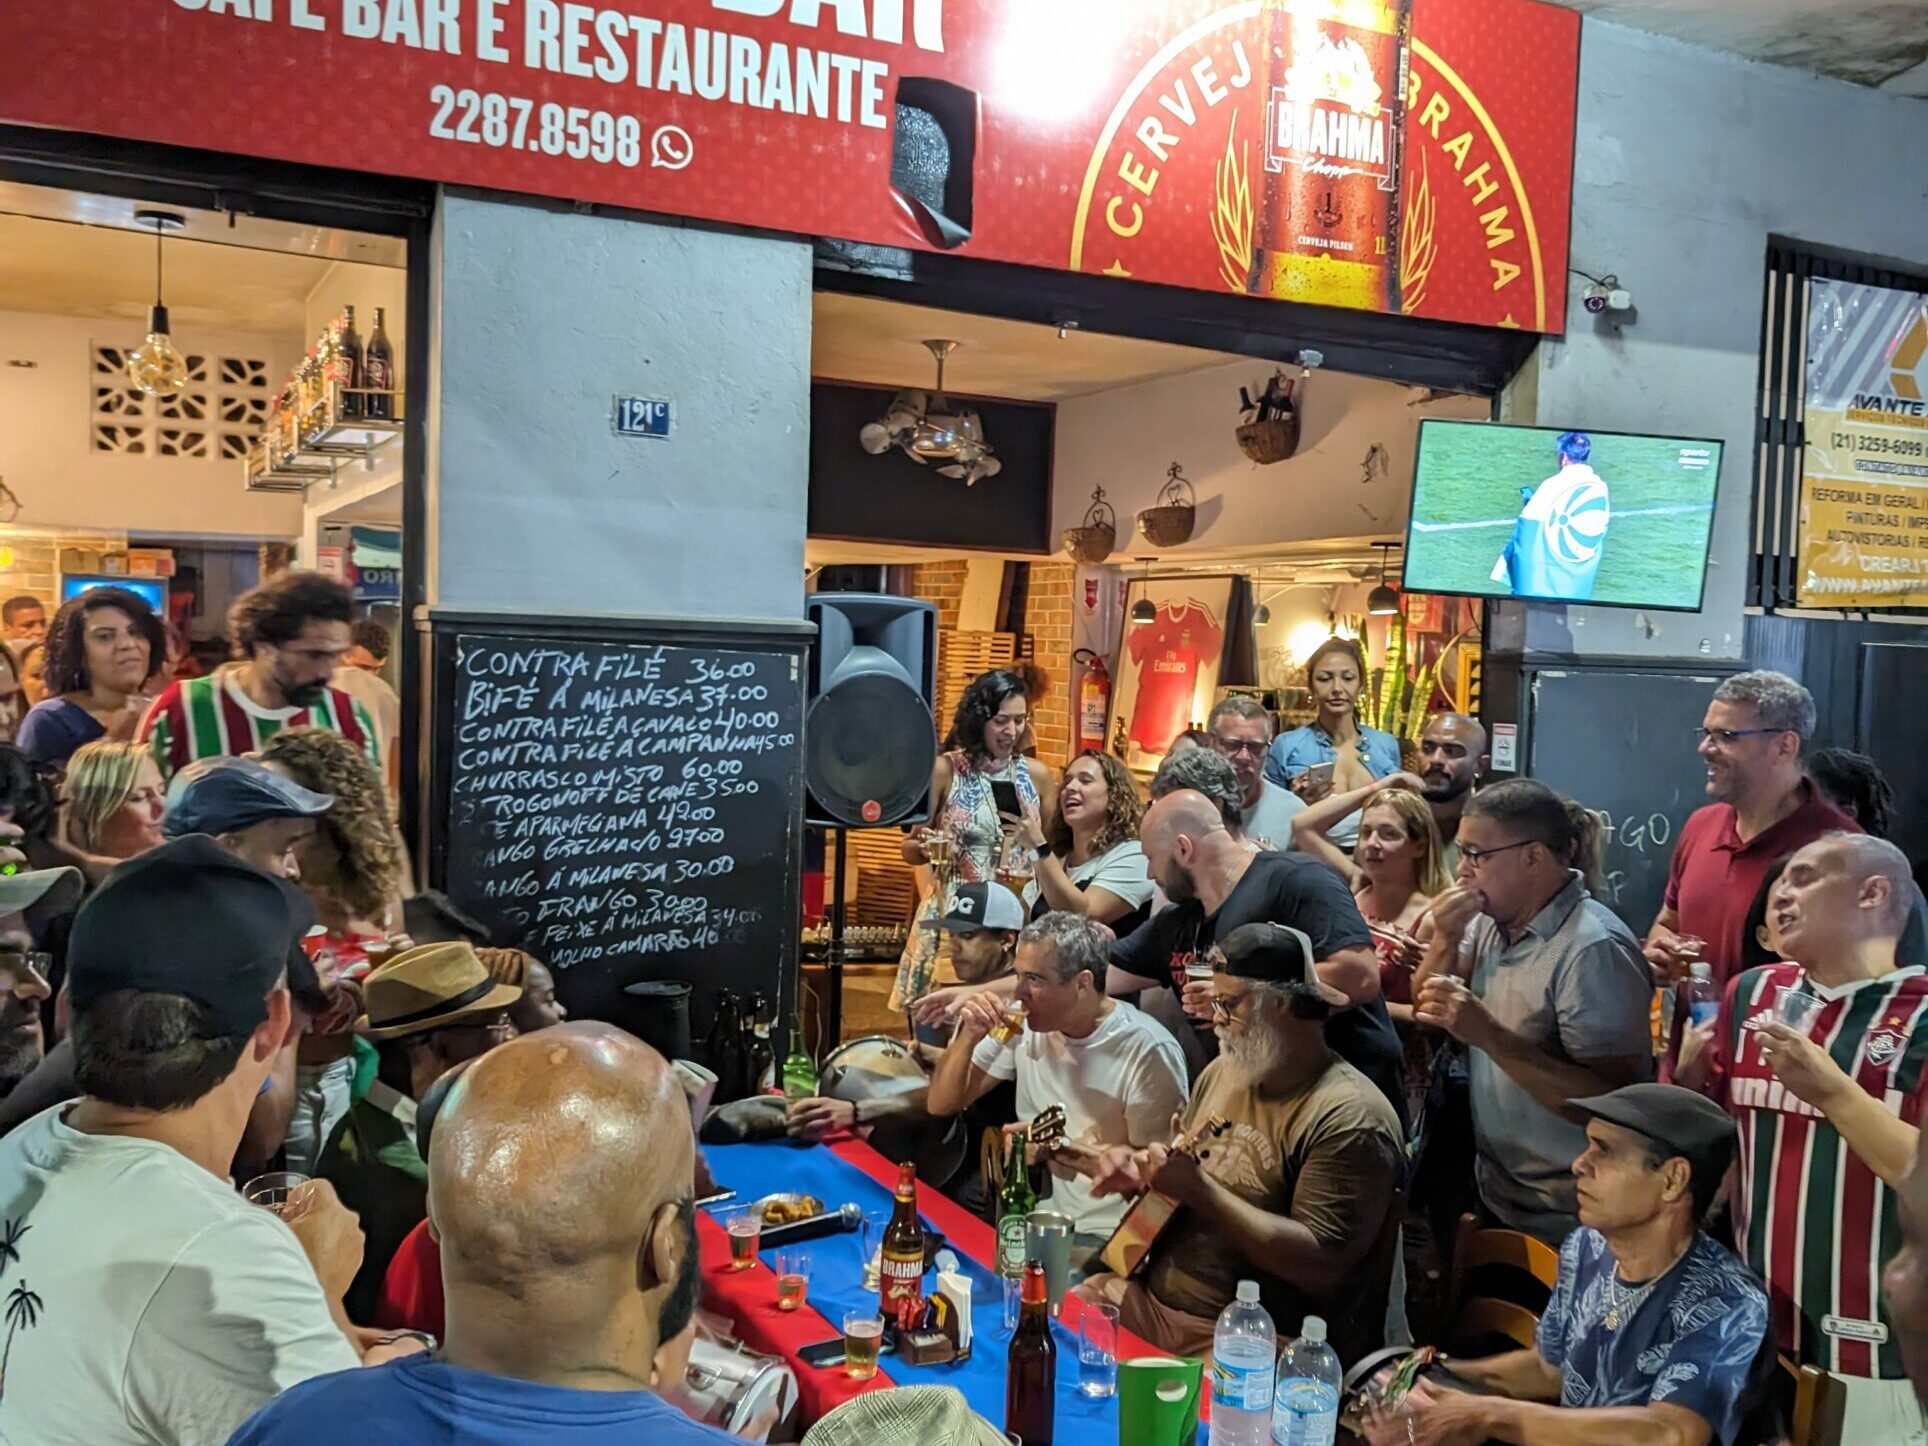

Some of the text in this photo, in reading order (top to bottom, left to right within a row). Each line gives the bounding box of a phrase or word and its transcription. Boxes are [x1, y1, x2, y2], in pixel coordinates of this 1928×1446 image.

[343, 0, 461, 56] BAR
[476, 0, 510, 64] E
[523, 0, 889, 130] RESTAURANTE
[429, 85, 641, 168] 2287.8598
[1278, 100, 1385, 165] BRAHMA
[1848, 394, 1925, 417] AVANTE
[466, 648, 591, 677] CONTRA
